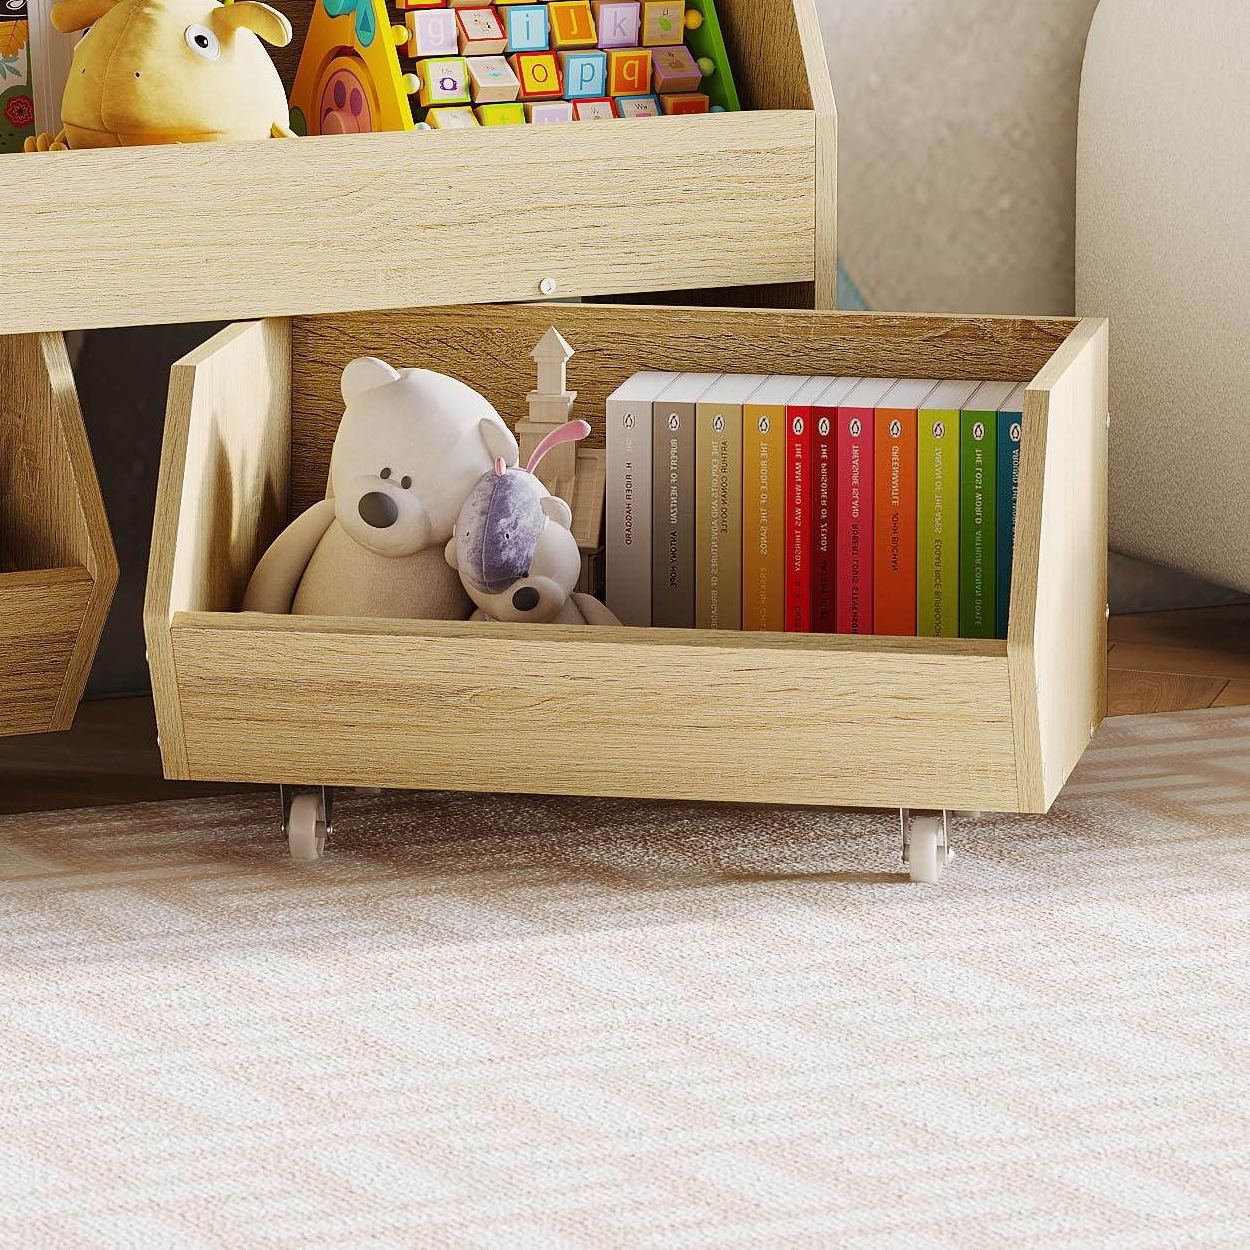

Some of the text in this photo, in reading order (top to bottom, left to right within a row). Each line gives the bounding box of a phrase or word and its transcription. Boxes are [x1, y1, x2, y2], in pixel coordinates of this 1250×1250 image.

[525, 13, 530, 41] i
[579, 62, 596, 91] p
[622, 59, 639, 89] q
